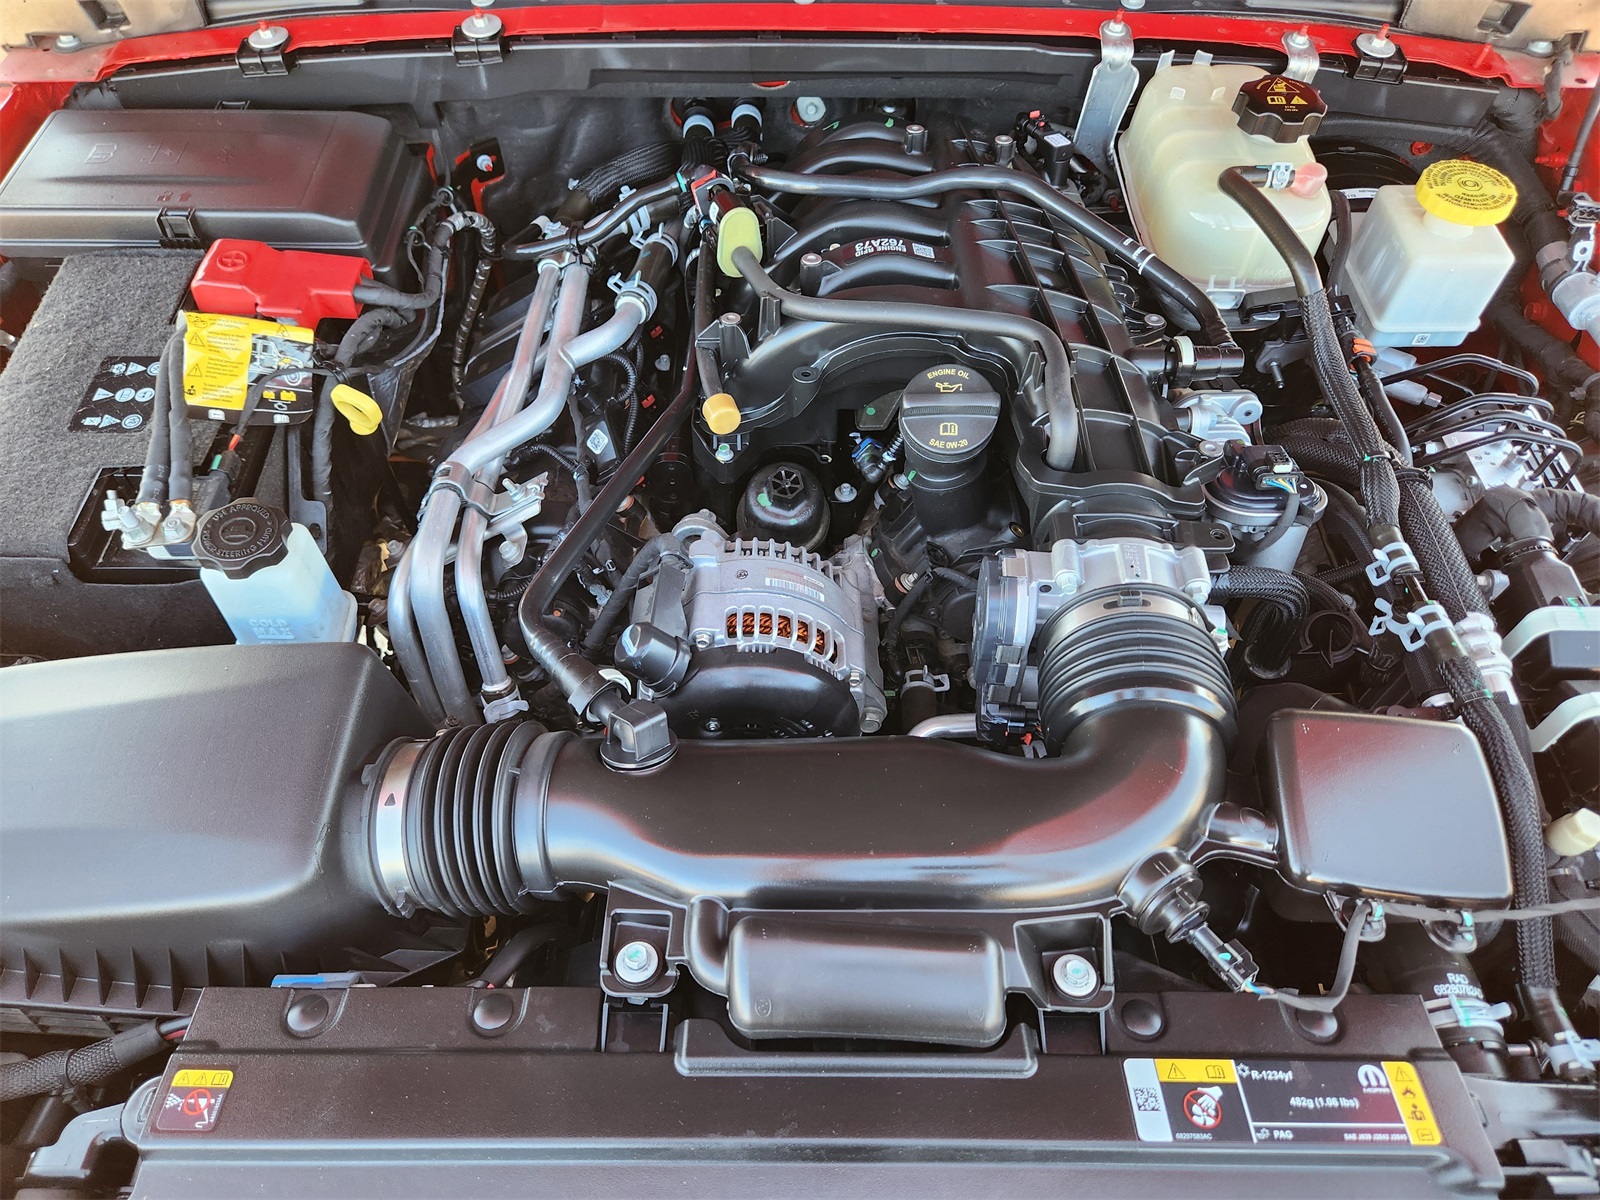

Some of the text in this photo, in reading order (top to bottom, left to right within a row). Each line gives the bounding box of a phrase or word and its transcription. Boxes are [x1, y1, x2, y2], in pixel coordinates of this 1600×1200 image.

[854, 238, 904, 252] 762A73
[855, 246, 875, 257] RFID
[926, 368, 970, 379] ENGINE OIL
[929, 438, 968, 449] SAE 0W-20
[212, 503, 271, 522] USE APPROVED
[202, 527, 273, 558] POWER STEERING FLUID
[249, 619, 289, 627] COLD
[252, 627, 293, 635] MAX
[1446, 972, 1469, 984] RAD
[1250, 1069, 1293, 1083] R-1234yf
[1289, 1096, 1360, 1110] 482g (1.06 lbs)
[1273, 1129, 1294, 1140] PAG
